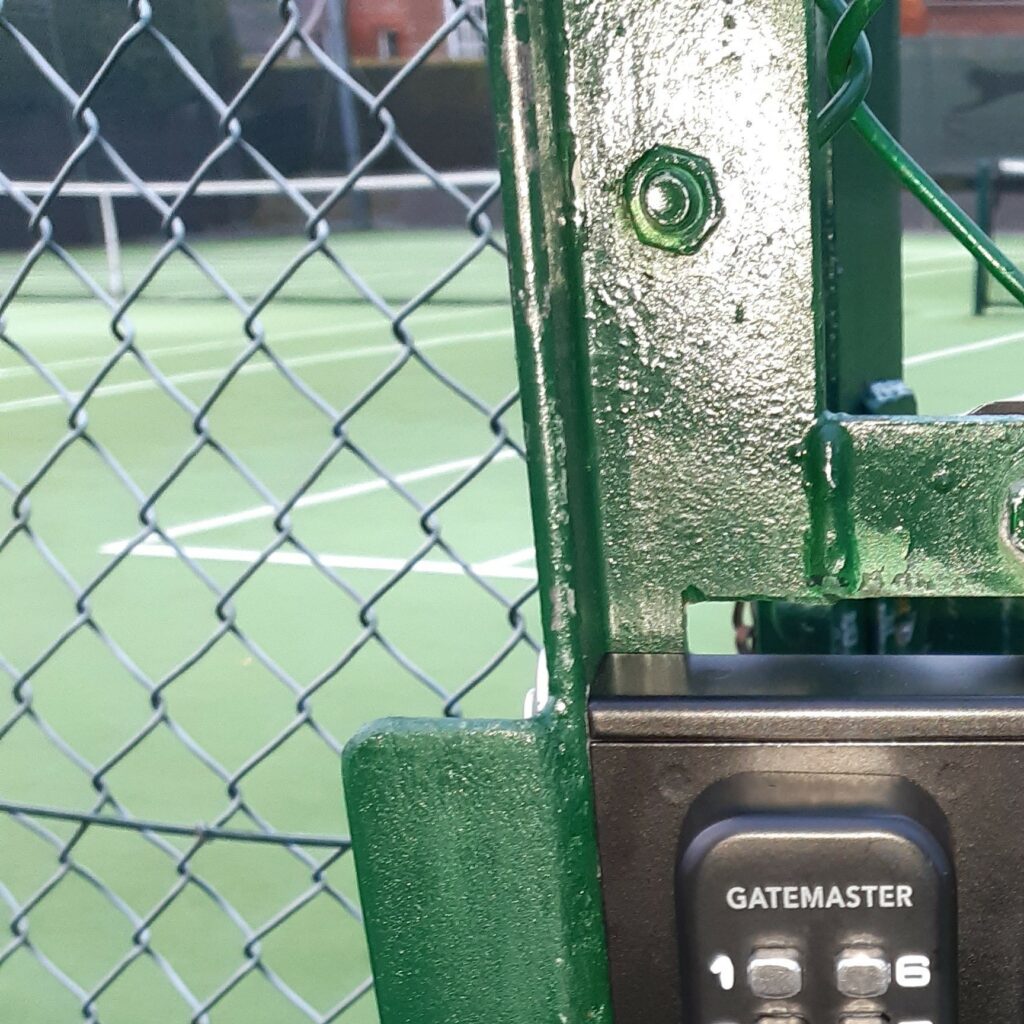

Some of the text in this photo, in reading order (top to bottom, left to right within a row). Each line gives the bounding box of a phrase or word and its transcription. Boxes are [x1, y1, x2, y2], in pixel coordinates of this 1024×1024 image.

[726, 885, 913, 909] GATEMASTER
[710, 954, 735, 990] 1
[895, 954, 931, 987] 6
